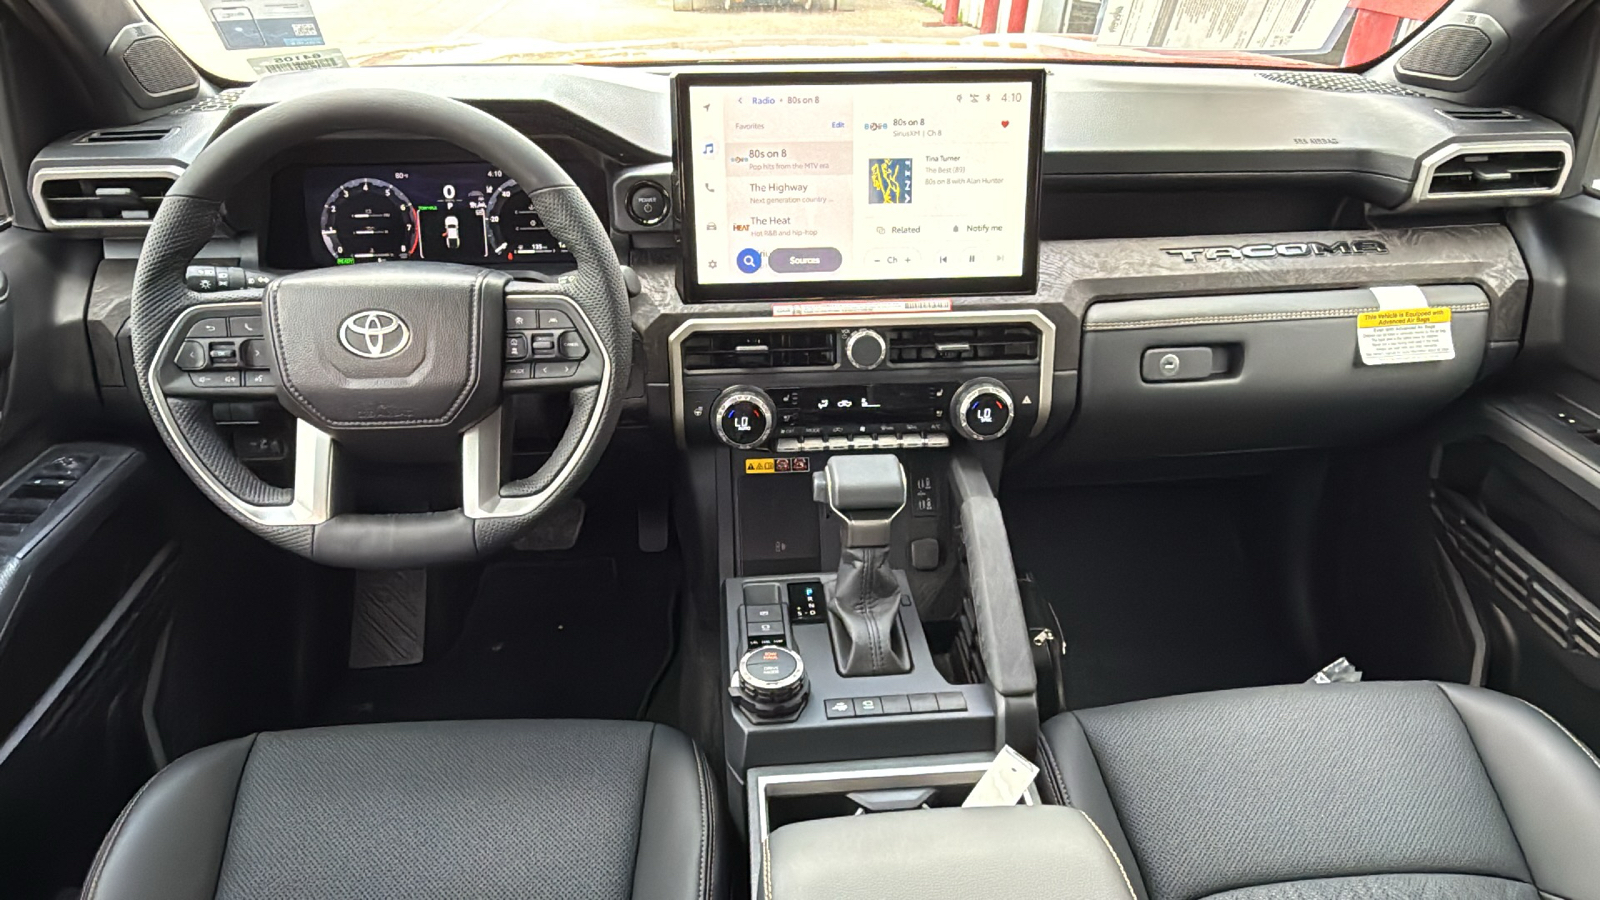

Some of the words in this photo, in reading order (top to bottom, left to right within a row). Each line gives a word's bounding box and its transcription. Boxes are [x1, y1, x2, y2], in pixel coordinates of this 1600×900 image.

[752, 96, 776, 105] Radio
[787, 96, 801, 104] 80s
[814, 96, 820, 104] 8
[1001, 92, 1022, 102] 4:10
[892, 118, 906, 126] 80s
[920, 118, 925, 126] 8
[748, 150, 765, 158] 80s
[780, 149, 787, 158] 8
[748, 164, 762, 172] Pop
[952, 166, 966, 174] (89)
[384, 188, 390, 196] 5
[442, 184, 456, 200] 0
[750, 183, 767, 192] The
[768, 183, 808, 194] Highway
[343, 190, 349, 198] 3
[766, 196, 801, 205] generation
[750, 216, 768, 225] The
[769, 216, 791, 224] Heat
[891, 226, 921, 234] Related
[966, 224, 990, 233] Notify
[1160, 240, 1390, 263] TACOMA
[790, 256, 820, 265] Sources
[886, 256, 898, 264] Ch
[1405, 311, 1432, 319] Equipped
[977, 408, 992, 418] LO
[734, 416, 748, 427] LO
[806, 588, 813, 596] P
